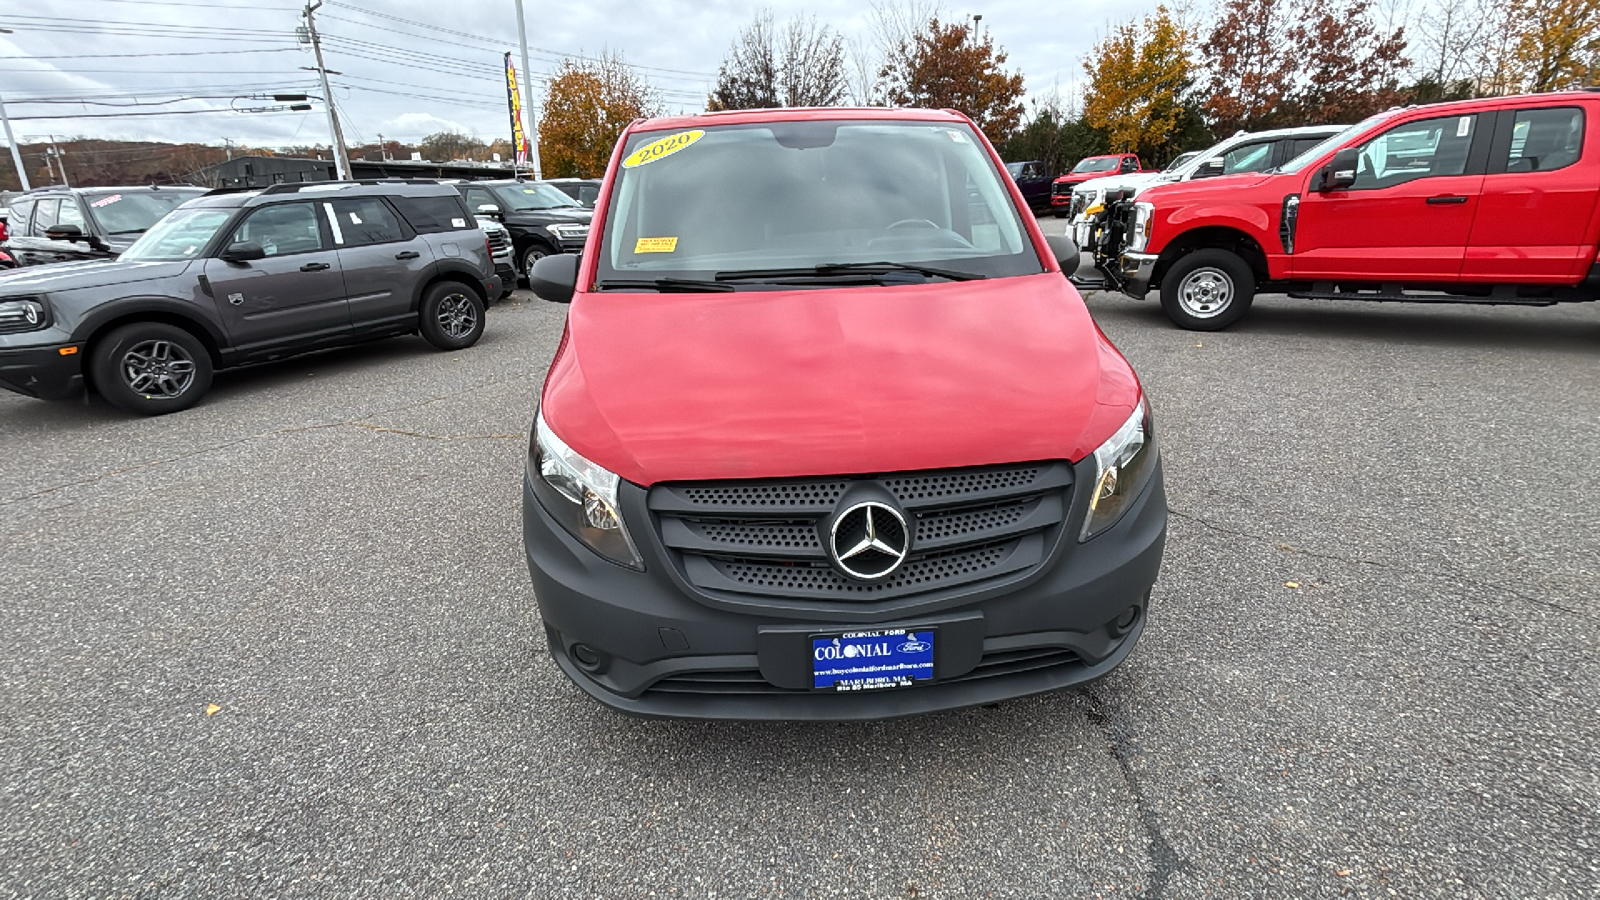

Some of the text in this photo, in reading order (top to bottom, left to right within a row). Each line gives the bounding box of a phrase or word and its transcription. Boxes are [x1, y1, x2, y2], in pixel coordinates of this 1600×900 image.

[639, 134, 690, 163] 2020
[843, 631, 880, 639] COLONIAL
[815, 643, 891, 661] COLONIAL
